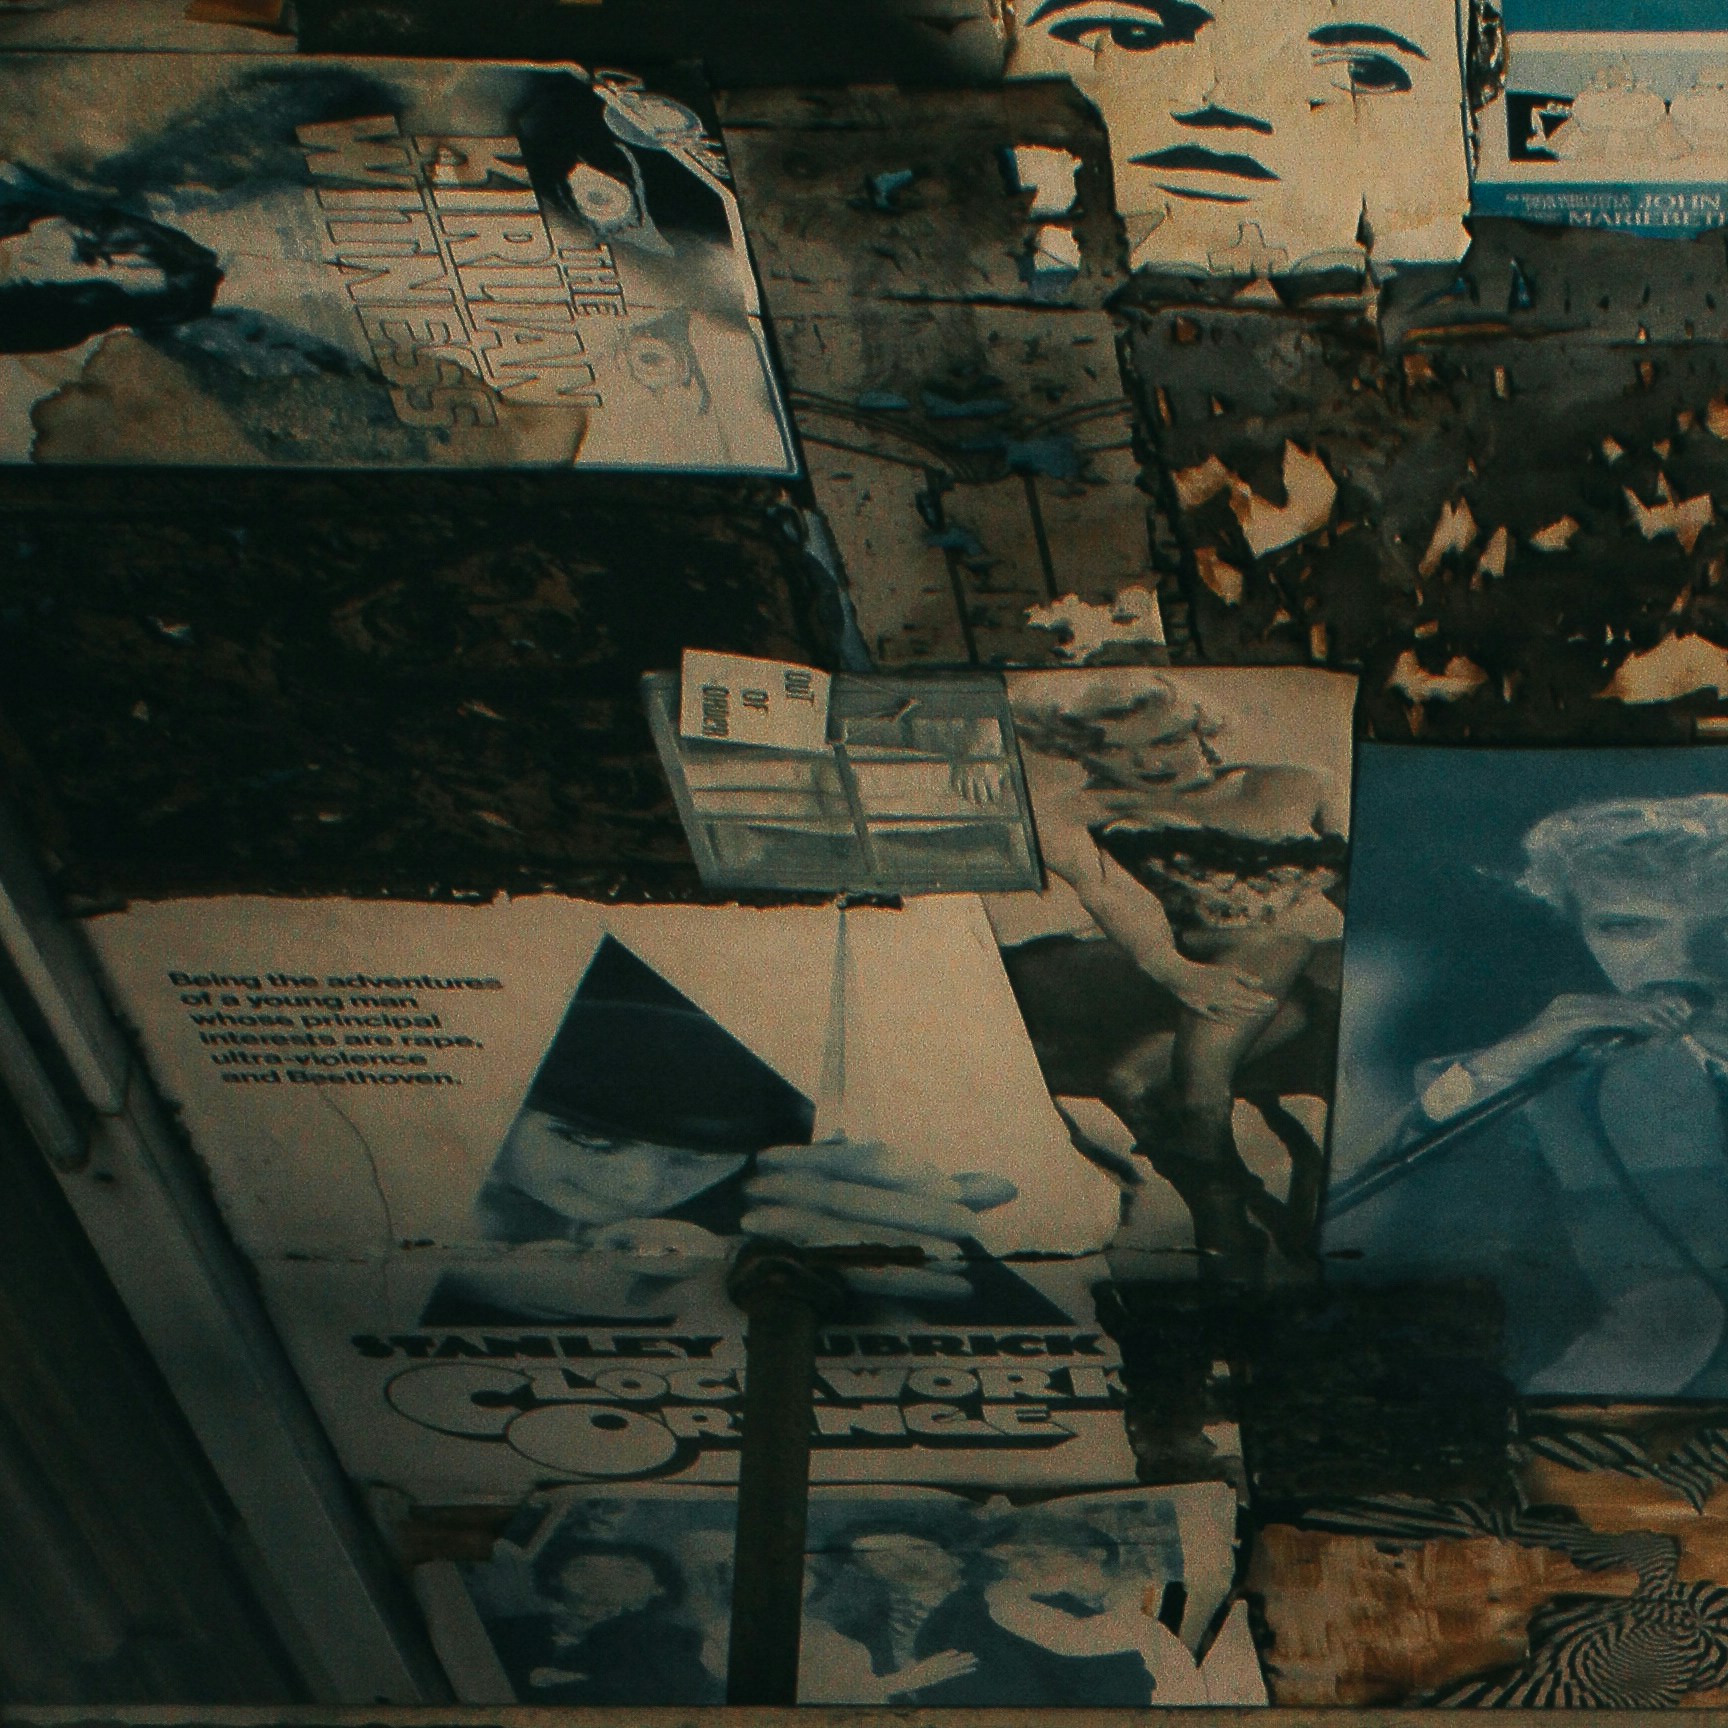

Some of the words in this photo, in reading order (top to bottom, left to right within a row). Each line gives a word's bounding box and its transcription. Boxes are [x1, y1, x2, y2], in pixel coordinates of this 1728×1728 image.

[295, 115, 501, 430] WITNESS
[407, 136, 604, 409] KIRLIAN
[557, 243, 627, 318] THE
[741, 687, 770, 715] OF
[783, 668, 816, 707] OUT
[168, 971, 263, 990] Being
[266, 972, 320, 988] the
[326, 972, 504, 990] adventures
[180, 991, 212, 1007] of
[219, 993, 241, 1007] a
[246, 993, 345, 1011] young
[349, 993, 420, 1009] man
[189, 1011, 296, 1027] whose
[300, 1012, 443, 1030] principal
[199, 1031, 337, 1047] interests
[344, 1033, 394, 1047] are
[400, 1034, 485, 1050] rape,
[210, 1050, 428, 1067] ultra-violence
[221, 1069, 283, 1085] and
[285, 1068, 463, 1087] Beethoven.
[350, 1333, 725, 1360] STANLEY
[744, 1333, 1106, 1359] UBRICK
[383, 1361, 1128, 1441] CLOCWORK
[506, 1404, 1080, 1480] ORNGE
